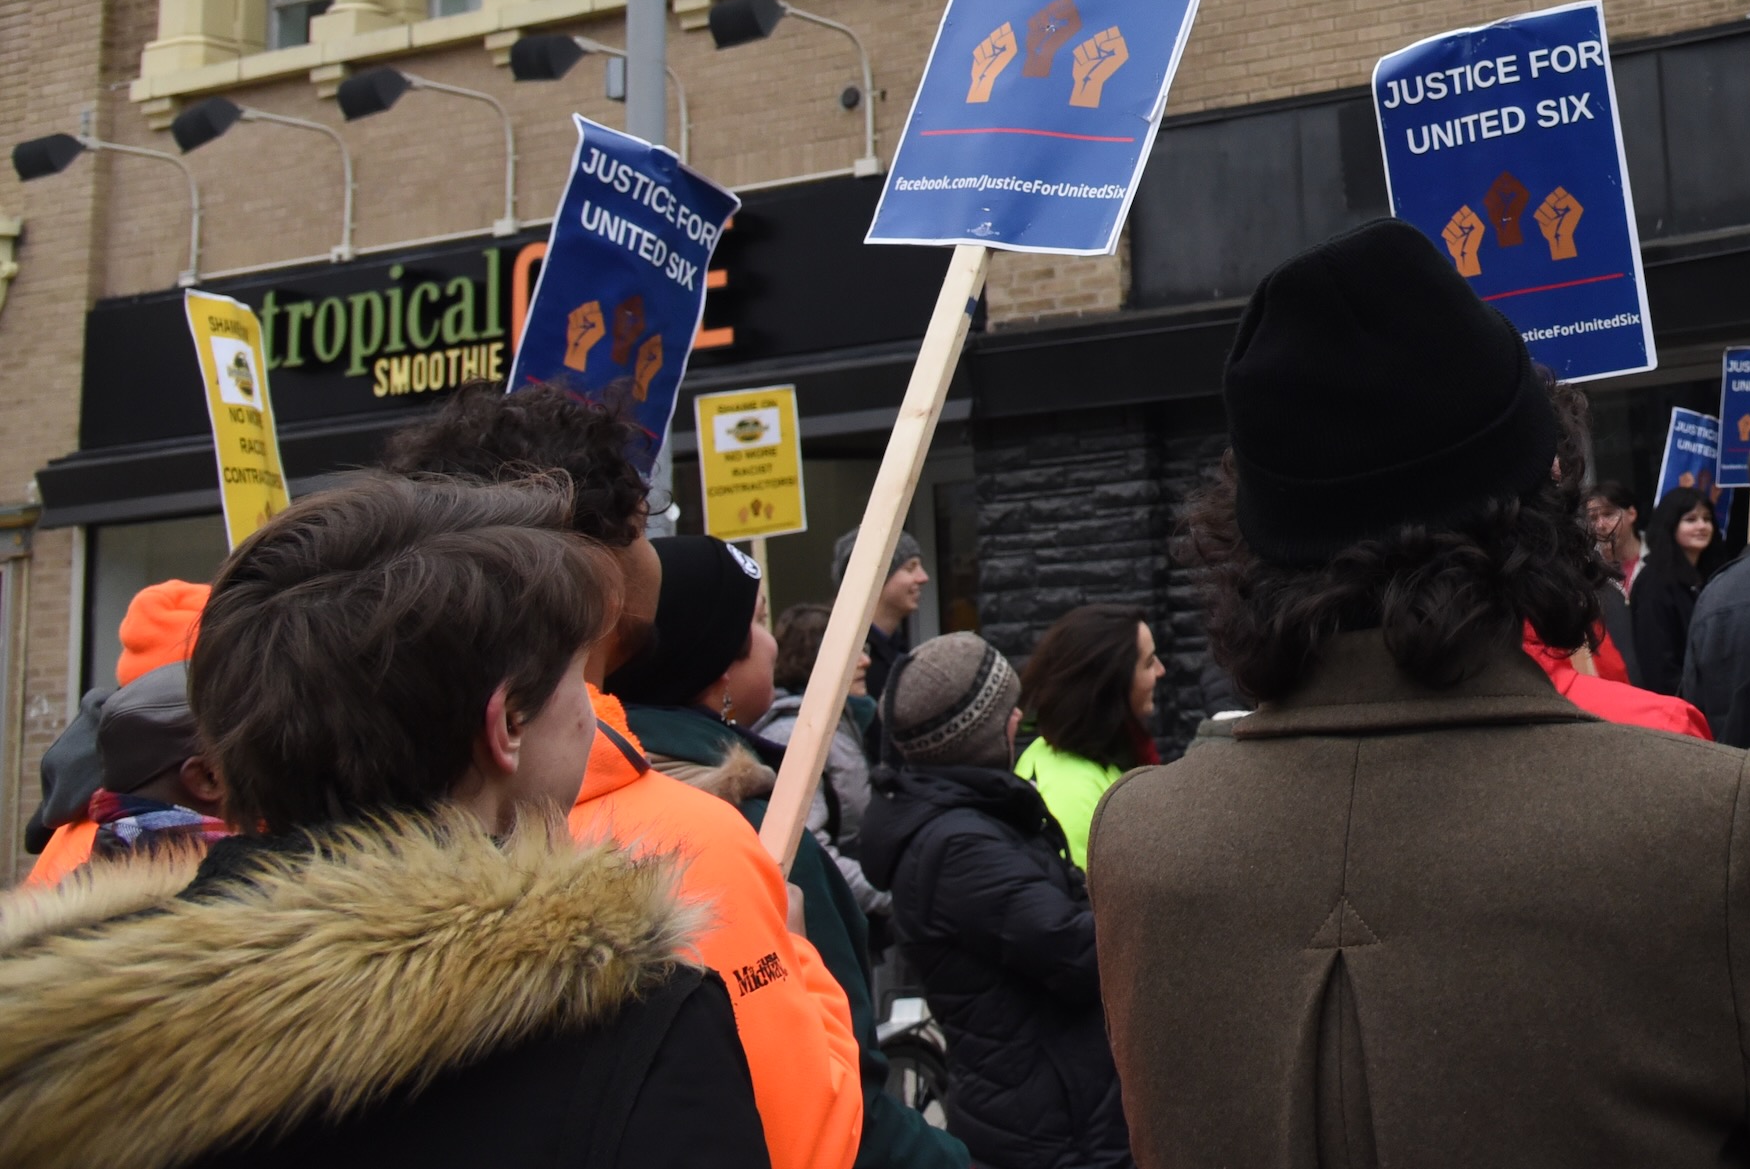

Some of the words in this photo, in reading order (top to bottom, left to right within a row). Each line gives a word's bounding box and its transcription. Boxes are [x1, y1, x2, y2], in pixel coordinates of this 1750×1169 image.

[1383, 55, 1520, 109] JUSTICE
[1529, 40, 1604, 79] FOR
[1406, 106, 1526, 155] UNITED
[1537, 92, 1595, 128] SIX
[582, 148, 676, 223] JUSTICE
[676, 207, 720, 252] FOR
[894, 174, 1126, 199] facebook.com/JusticeForUnitedSix
[581, 200, 667, 268] UNITED
[666, 253, 698, 291] SIX
[261, 249, 504, 376] tropical
[1521, 313, 1640, 343] sticeForUnitedSix
[373, 342, 504, 398] SMOOTHIE
